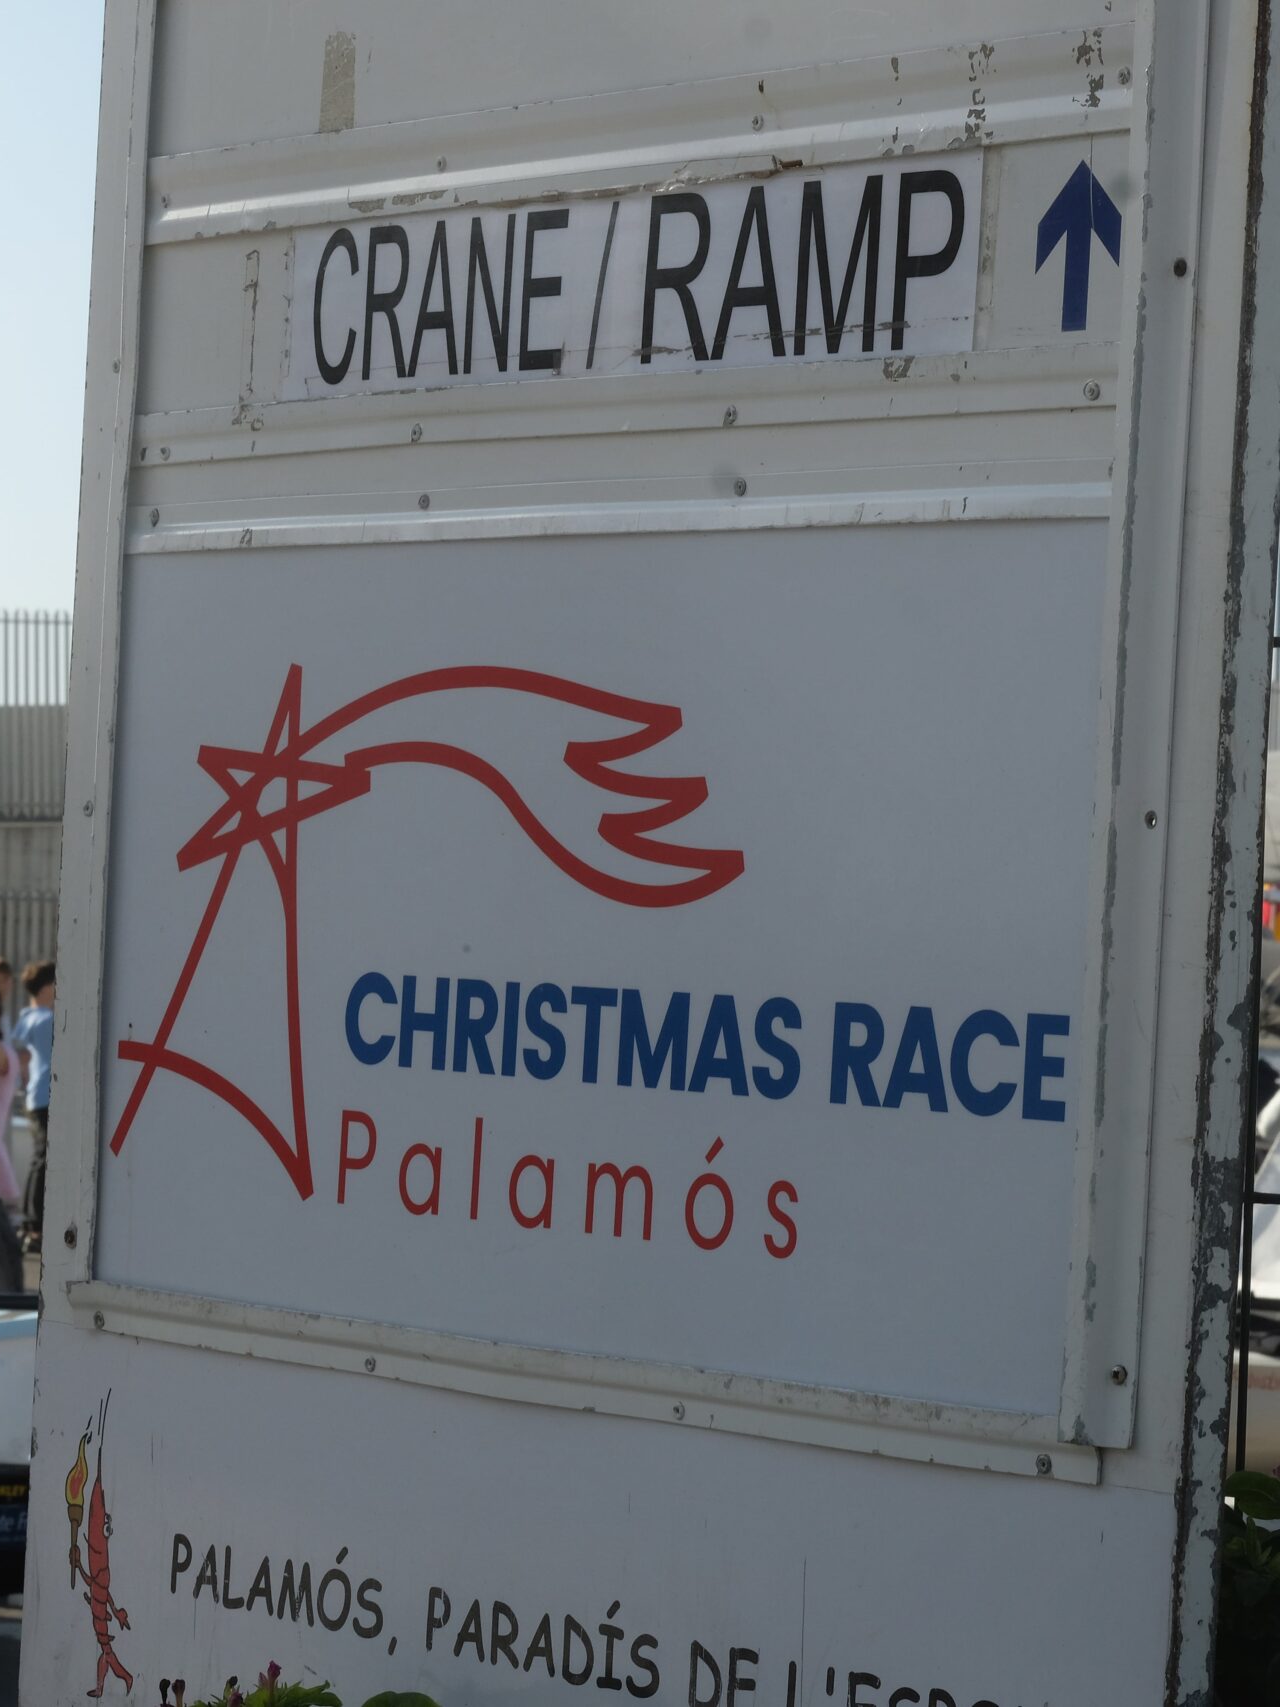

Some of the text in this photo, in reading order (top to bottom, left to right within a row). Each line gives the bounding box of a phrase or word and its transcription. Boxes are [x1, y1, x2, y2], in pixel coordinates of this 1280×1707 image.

[344, 971, 1071, 1123] CHRISTMAS RACE
[336, 1109, 800, 1260] Palamós
[170, 1532, 399, 1657] PALAMÓS,
[425, 1585, 661, 1699] PARADÍS
